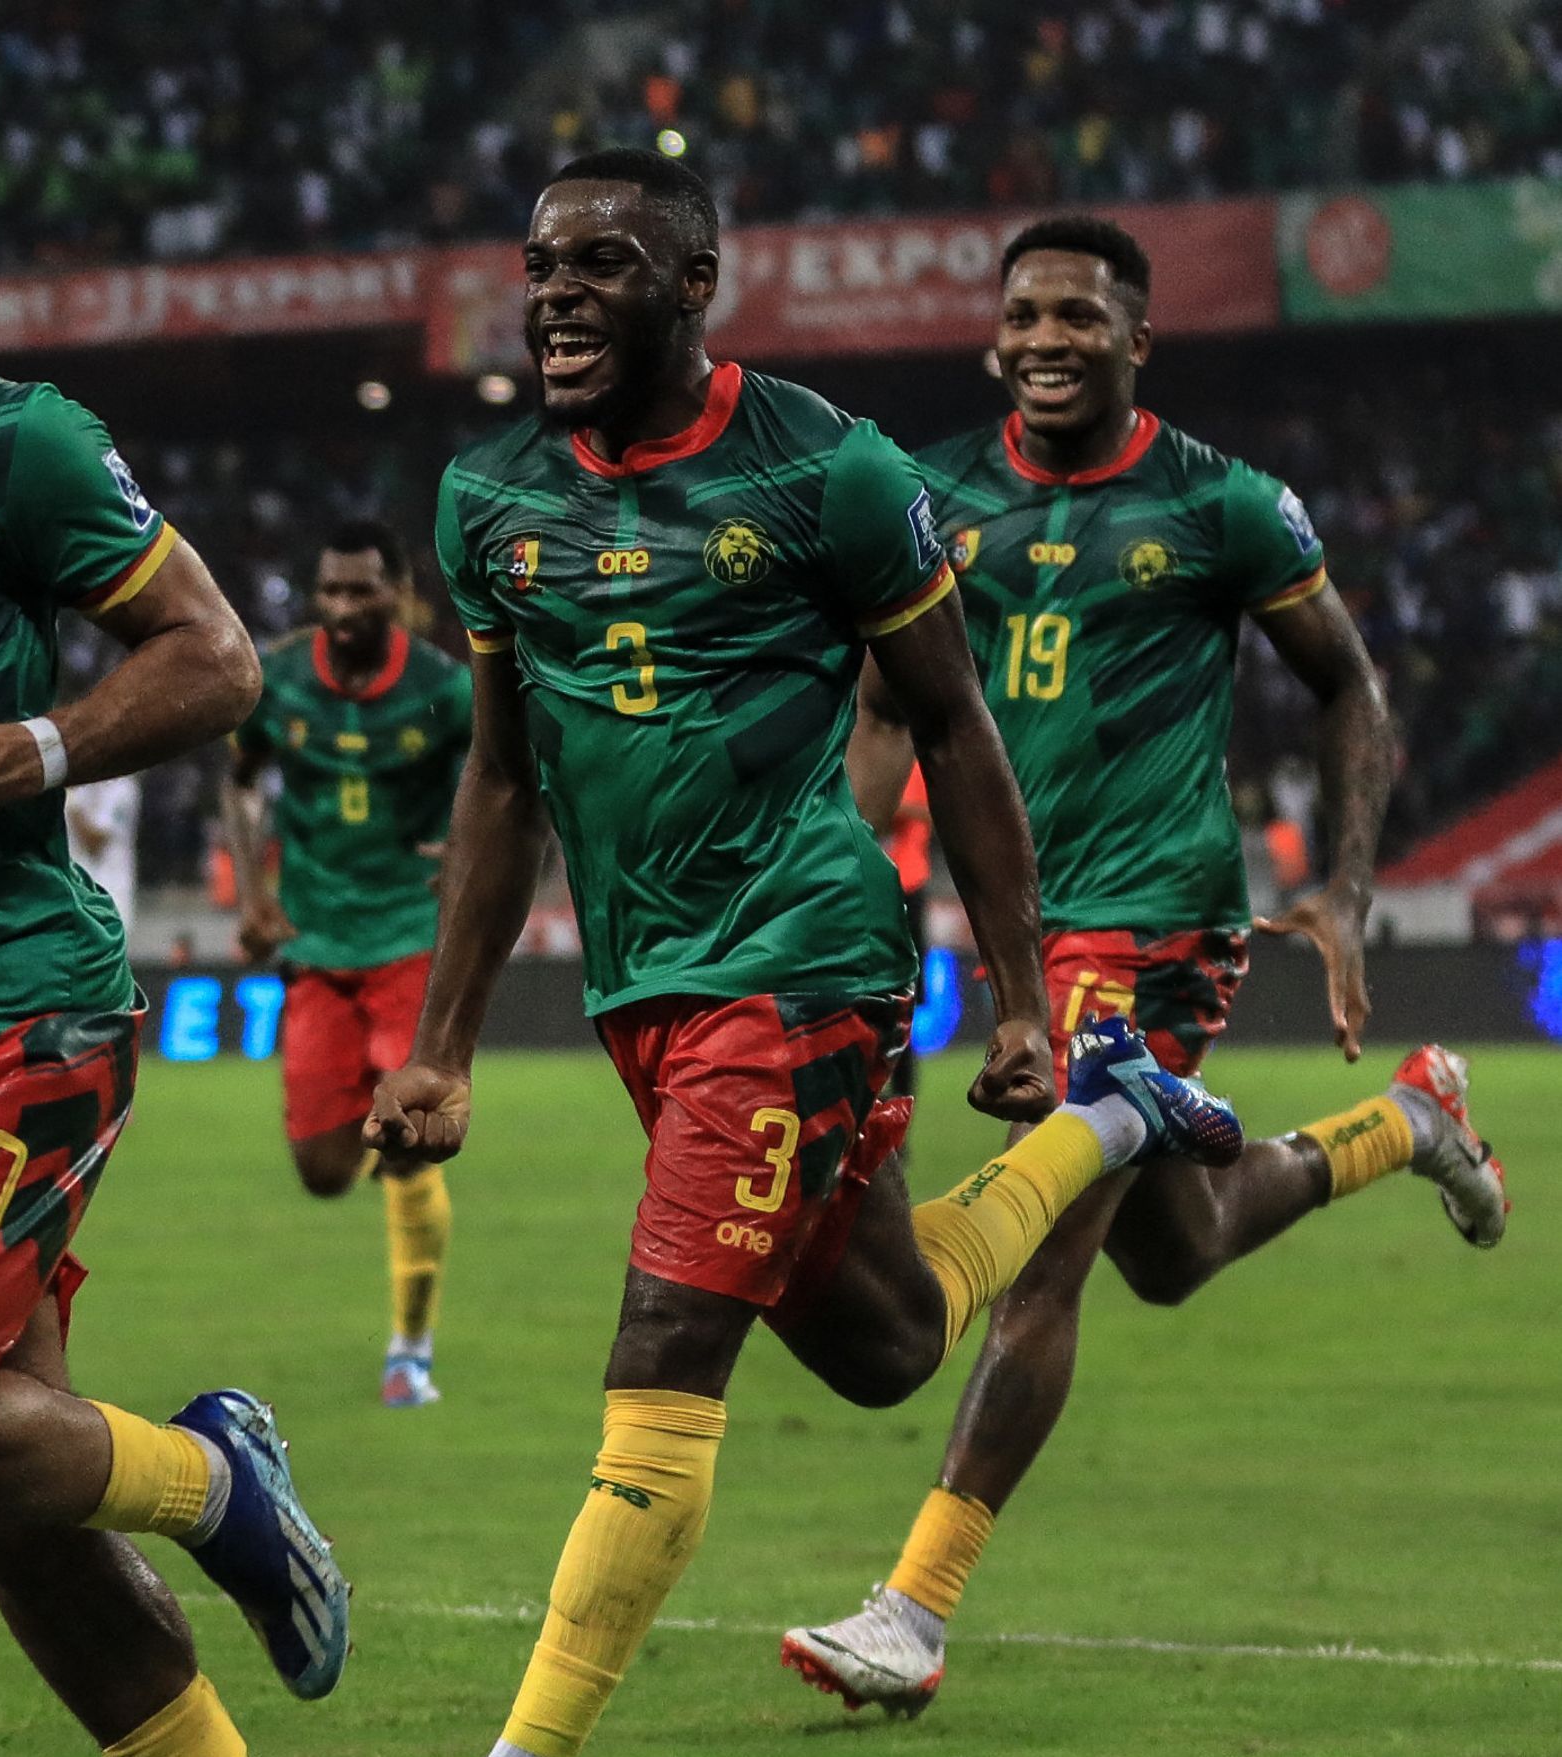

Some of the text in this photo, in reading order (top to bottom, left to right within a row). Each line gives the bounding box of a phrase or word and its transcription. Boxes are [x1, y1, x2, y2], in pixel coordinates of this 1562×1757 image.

[598, 550, 649, 574] one
[1029, 542, 1076, 566] one
[605, 622, 658, 715] 3
[1006, 613, 1071, 700] 19
[160, 975, 286, 1062] ET
[735, 1107, 800, 1213] 3
[716, 1222, 772, 1255] one
